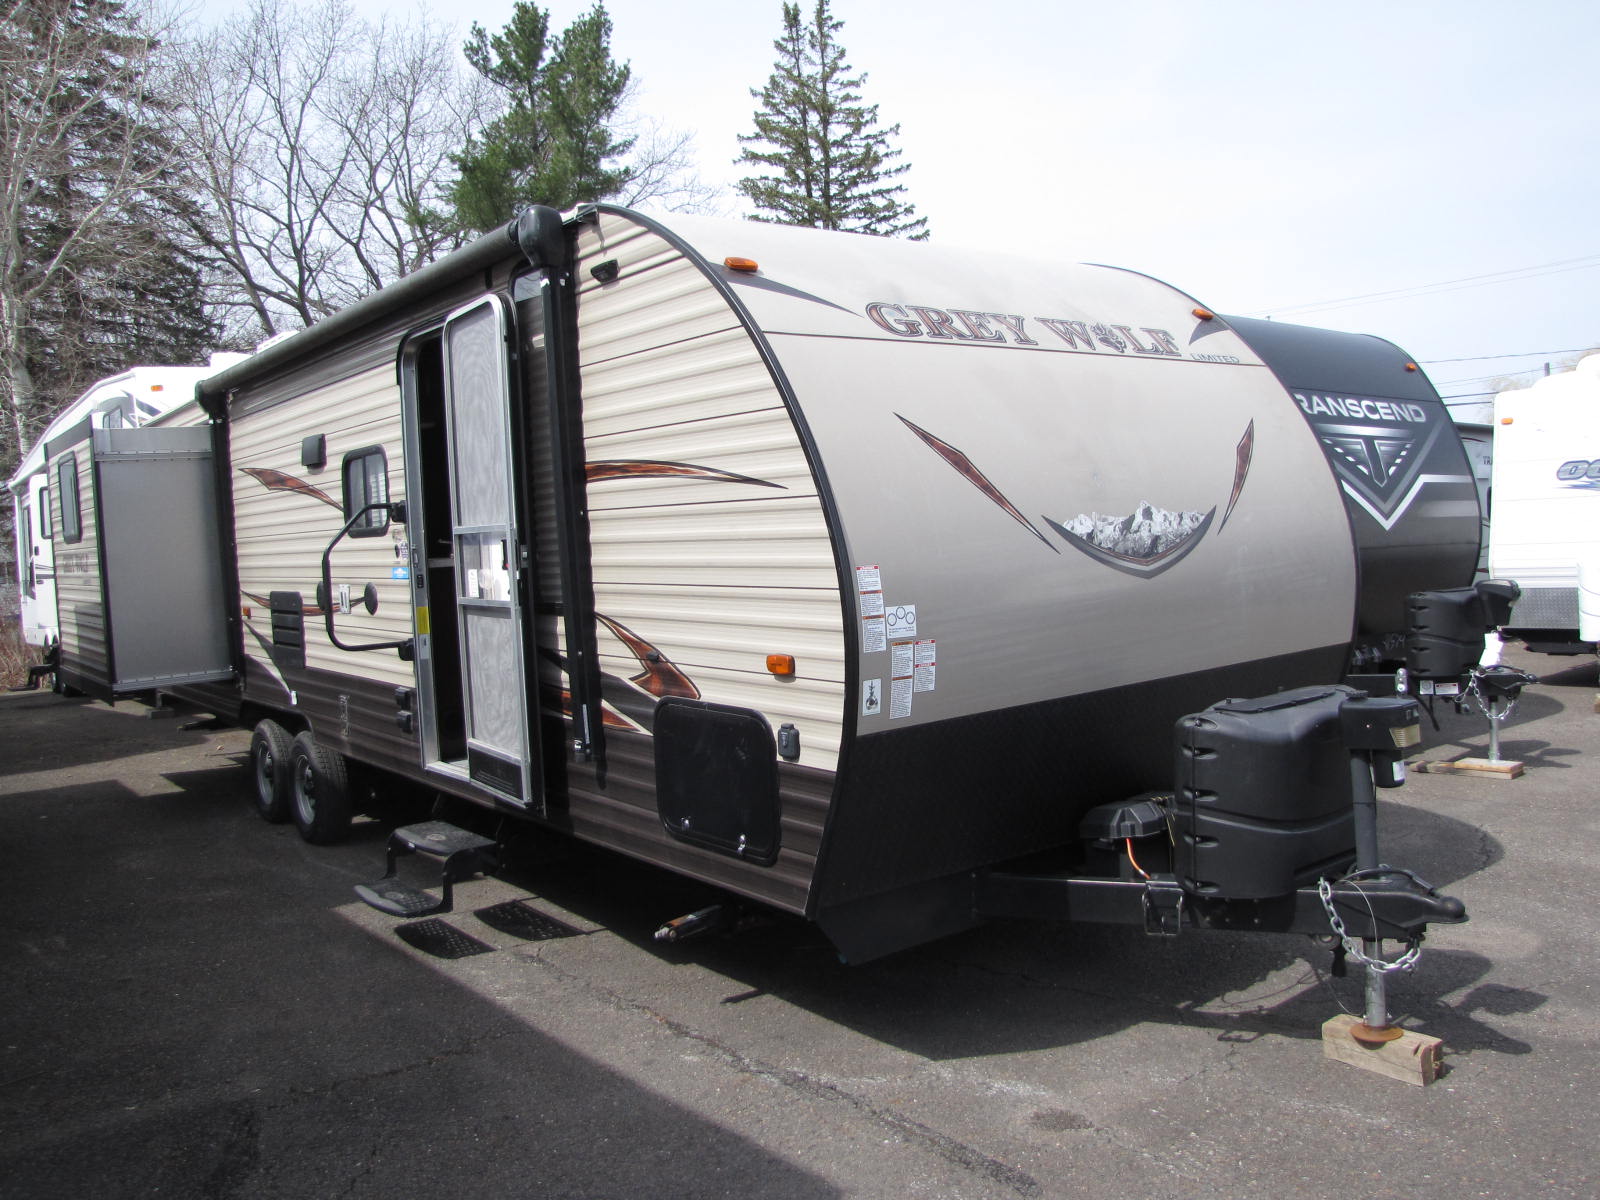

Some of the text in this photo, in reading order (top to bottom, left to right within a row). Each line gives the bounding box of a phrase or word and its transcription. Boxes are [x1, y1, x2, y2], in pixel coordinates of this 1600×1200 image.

[865, 301, 1039, 346] GREY
[1190, 353, 1240, 364] LIMITED
[1292, 393, 1426, 422] RANSCEND
